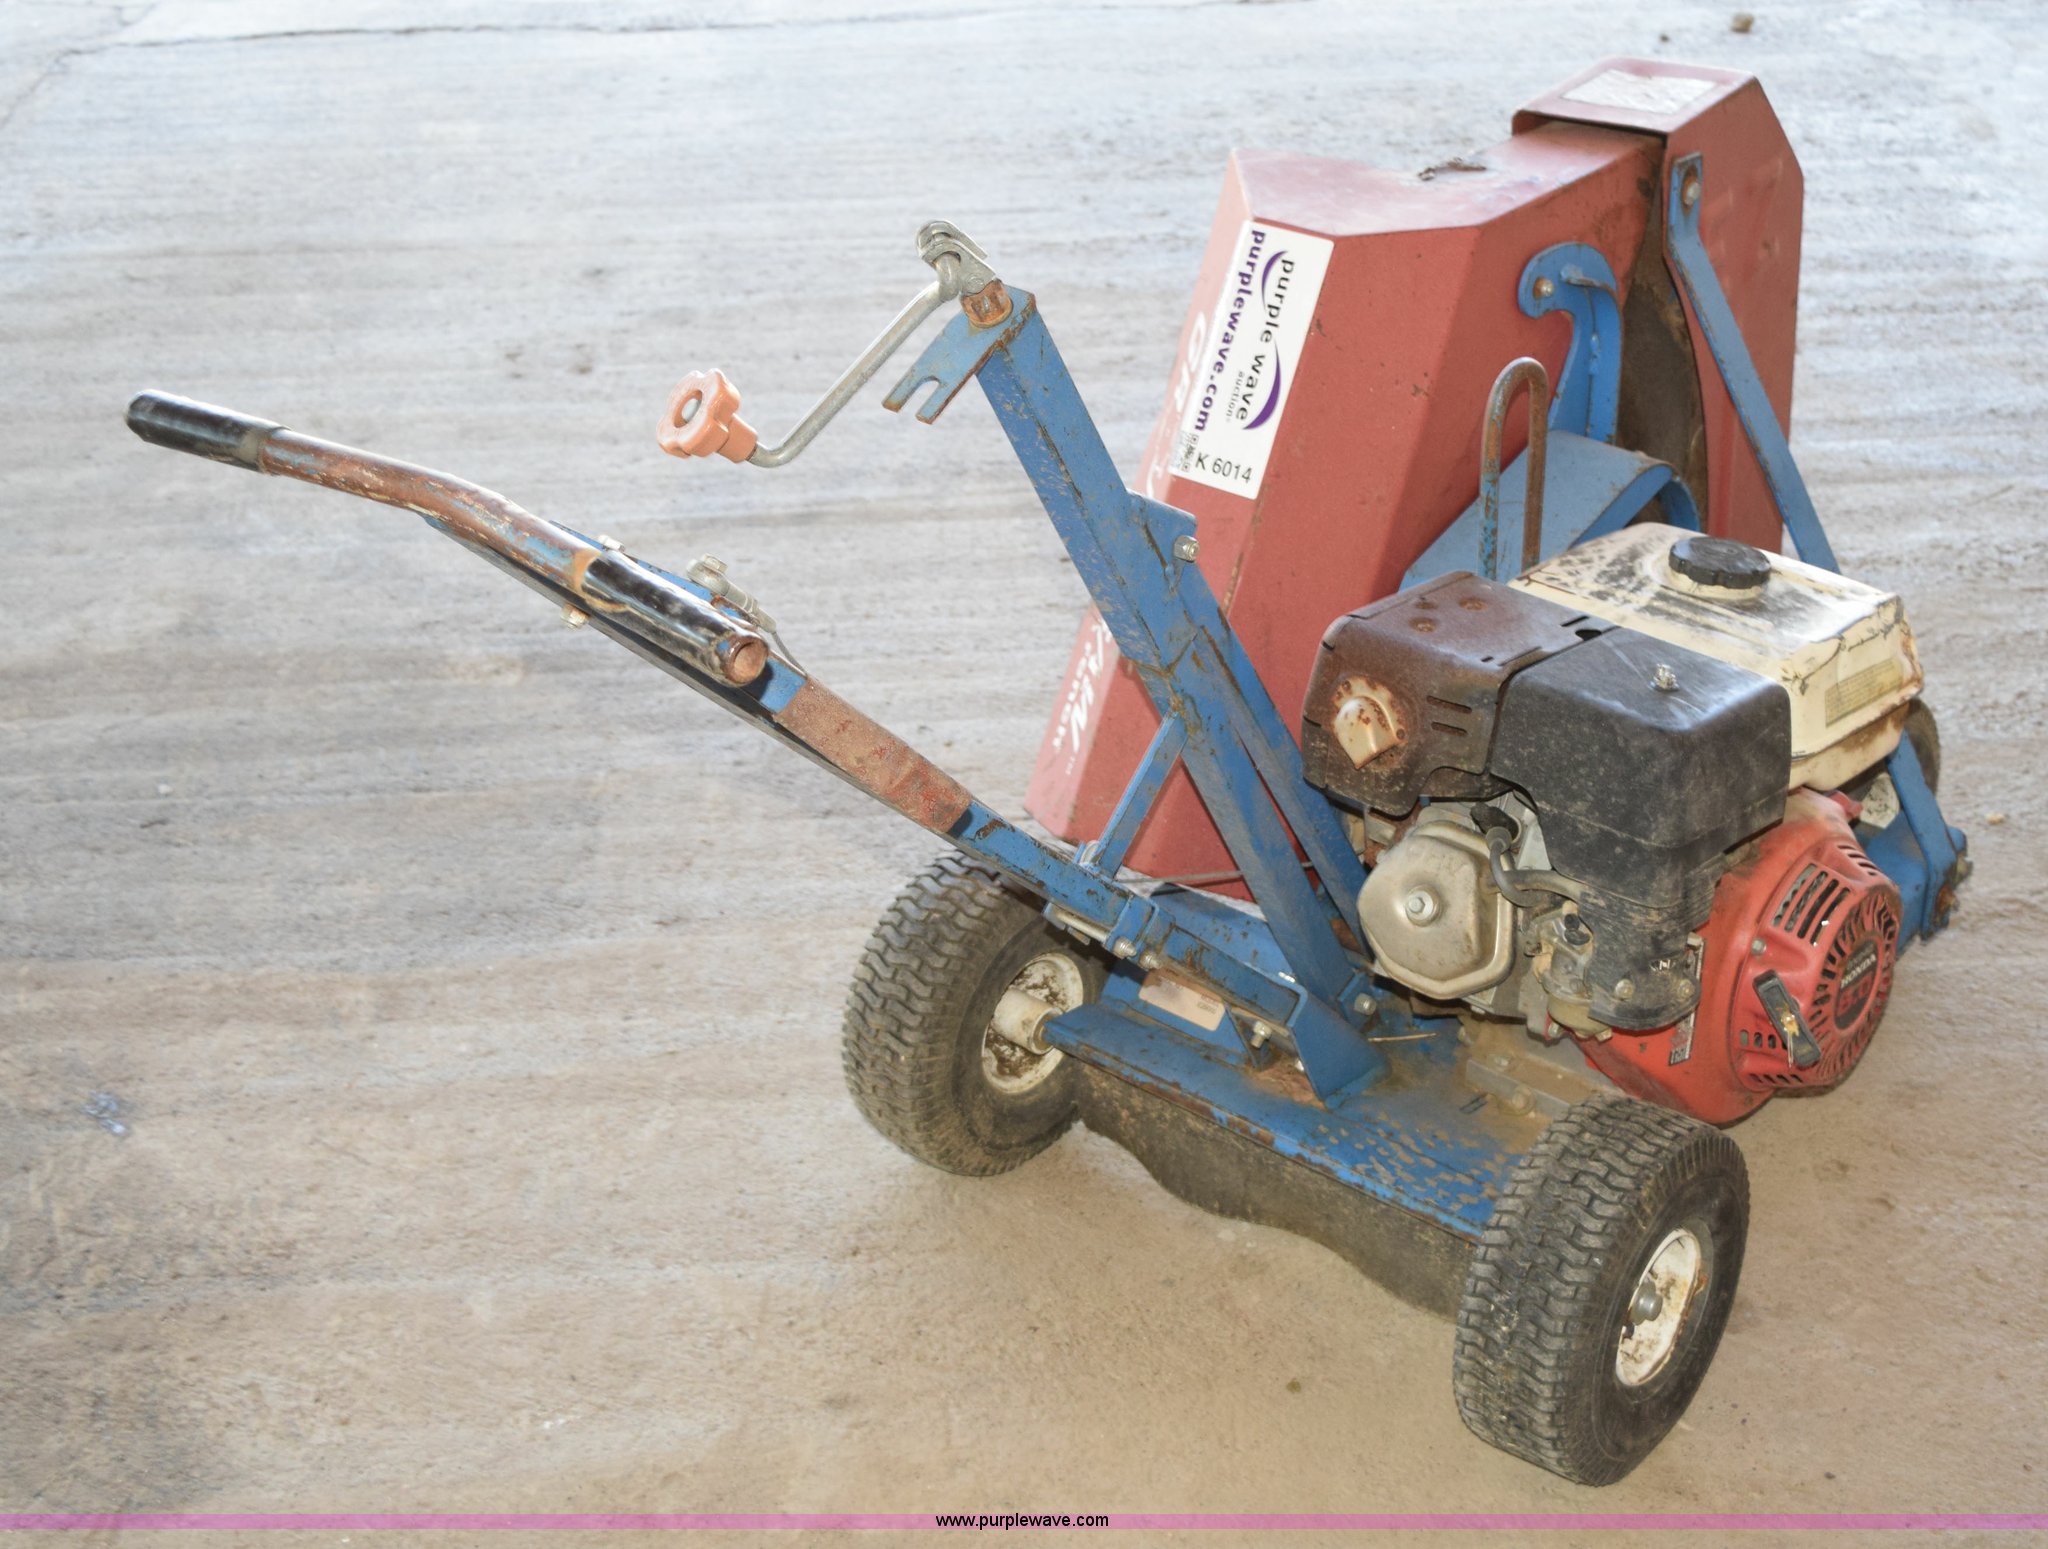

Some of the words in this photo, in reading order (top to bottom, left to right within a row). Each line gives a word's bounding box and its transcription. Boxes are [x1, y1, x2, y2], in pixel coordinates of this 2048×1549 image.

[1260, 258, 1295, 343] purple
[1194, 230, 1266, 431] purplewave.com
[1226, 370, 1246, 418] auction
[1236, 354, 1266, 421] wave
[1195, 452, 1209, 470] K
[1212, 458, 1253, 483] 6014
[1840, 953, 1877, 989] HONDA
